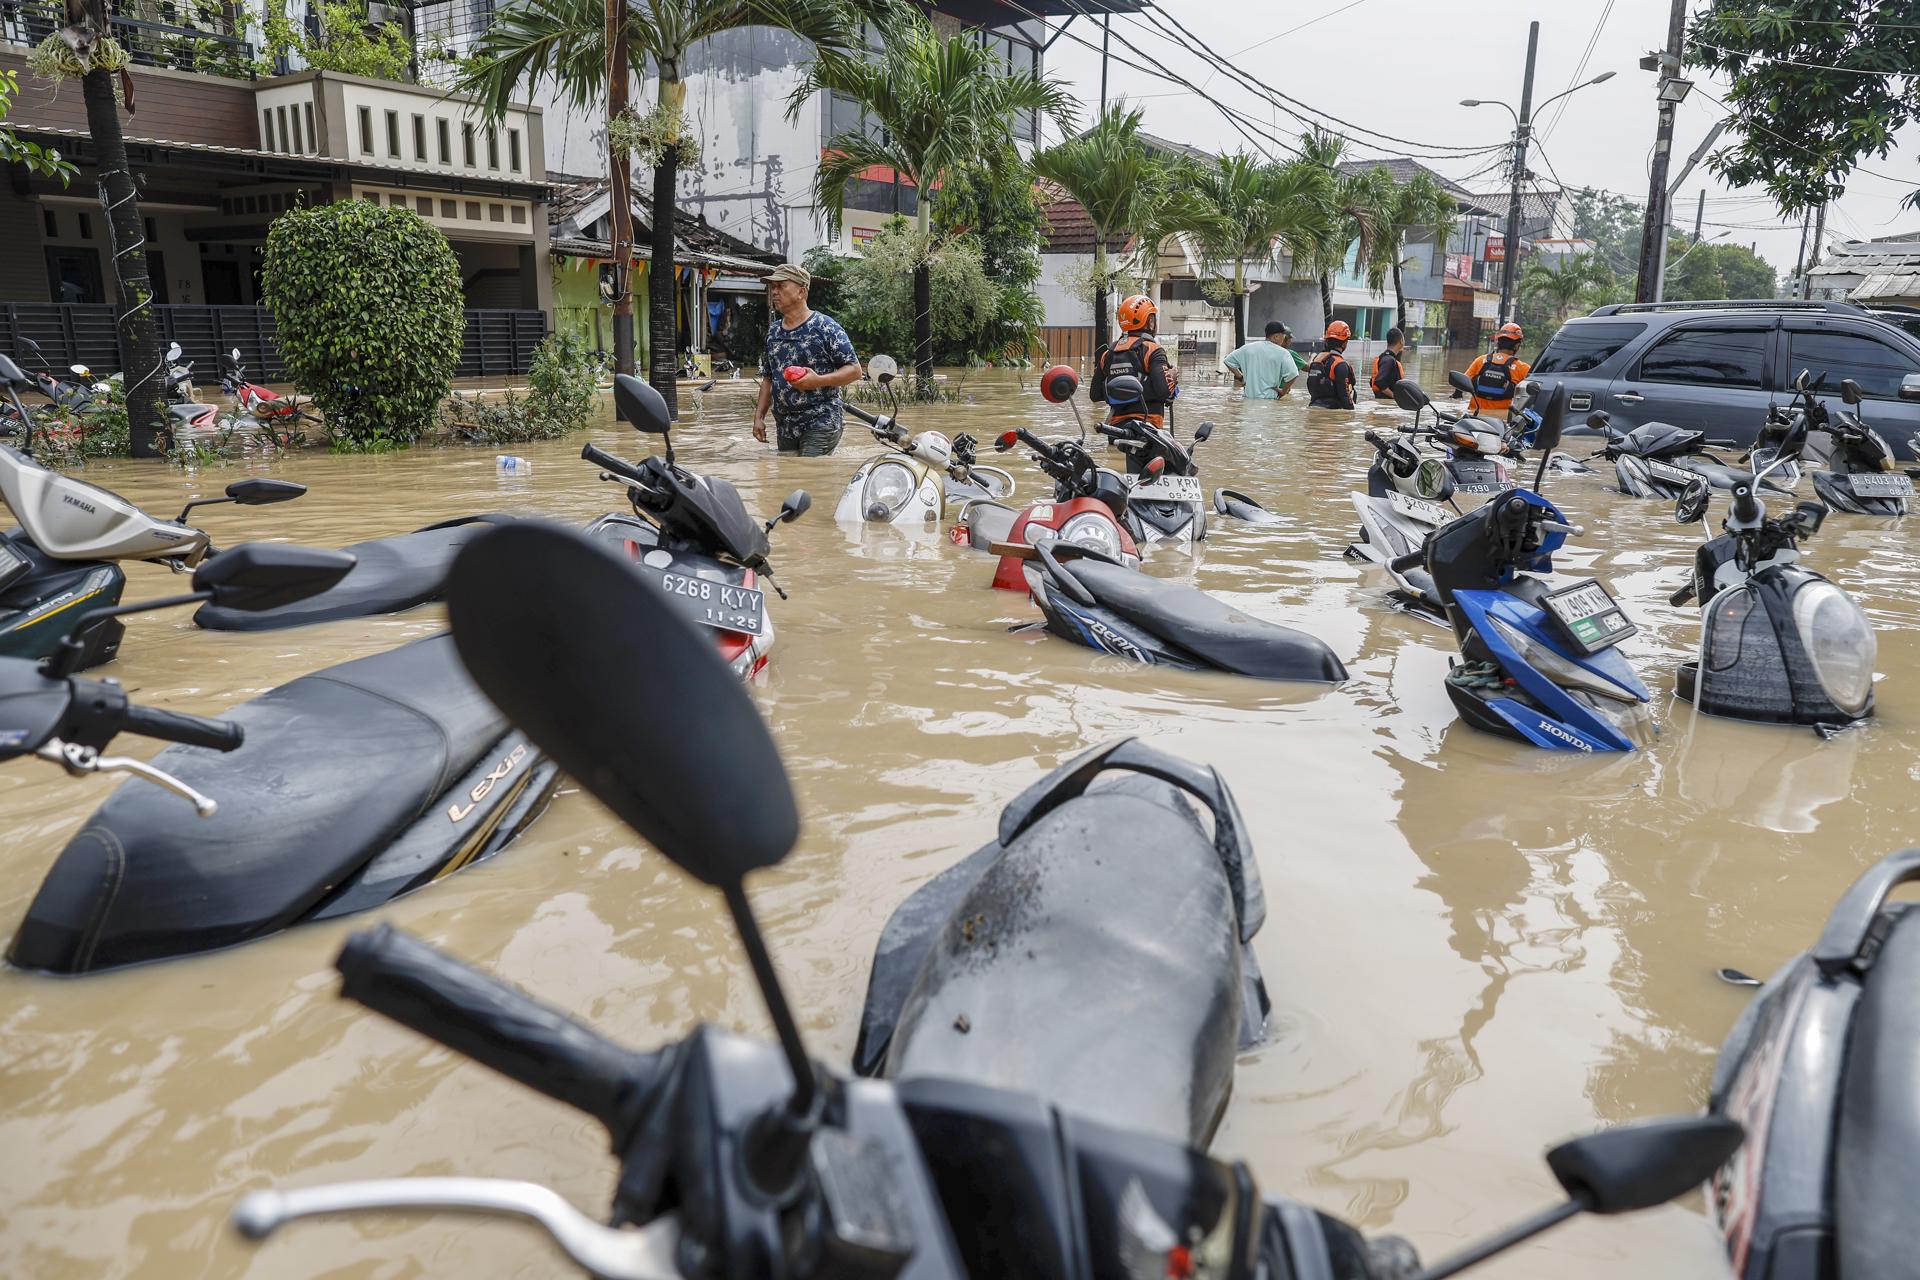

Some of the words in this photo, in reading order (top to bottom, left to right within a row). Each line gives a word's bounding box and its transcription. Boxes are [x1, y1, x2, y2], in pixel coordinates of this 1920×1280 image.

[1126, 475, 1134, 486] B
[1176, 478, 1199, 489] KRV
[1466, 484, 1490, 493] 4390
[1851, 475, 1859, 485] B
[1863, 475, 1889, 485] 6403
[62, 495, 96, 515] YAMAHA
[1403, 496, 1432, 513] 6202
[662, 574, 711, 600] 6268
[721, 587, 759, 611] KYY
[1563, 593, 1595, 618] 4909
[1538, 720, 1593, 753] HONDA
